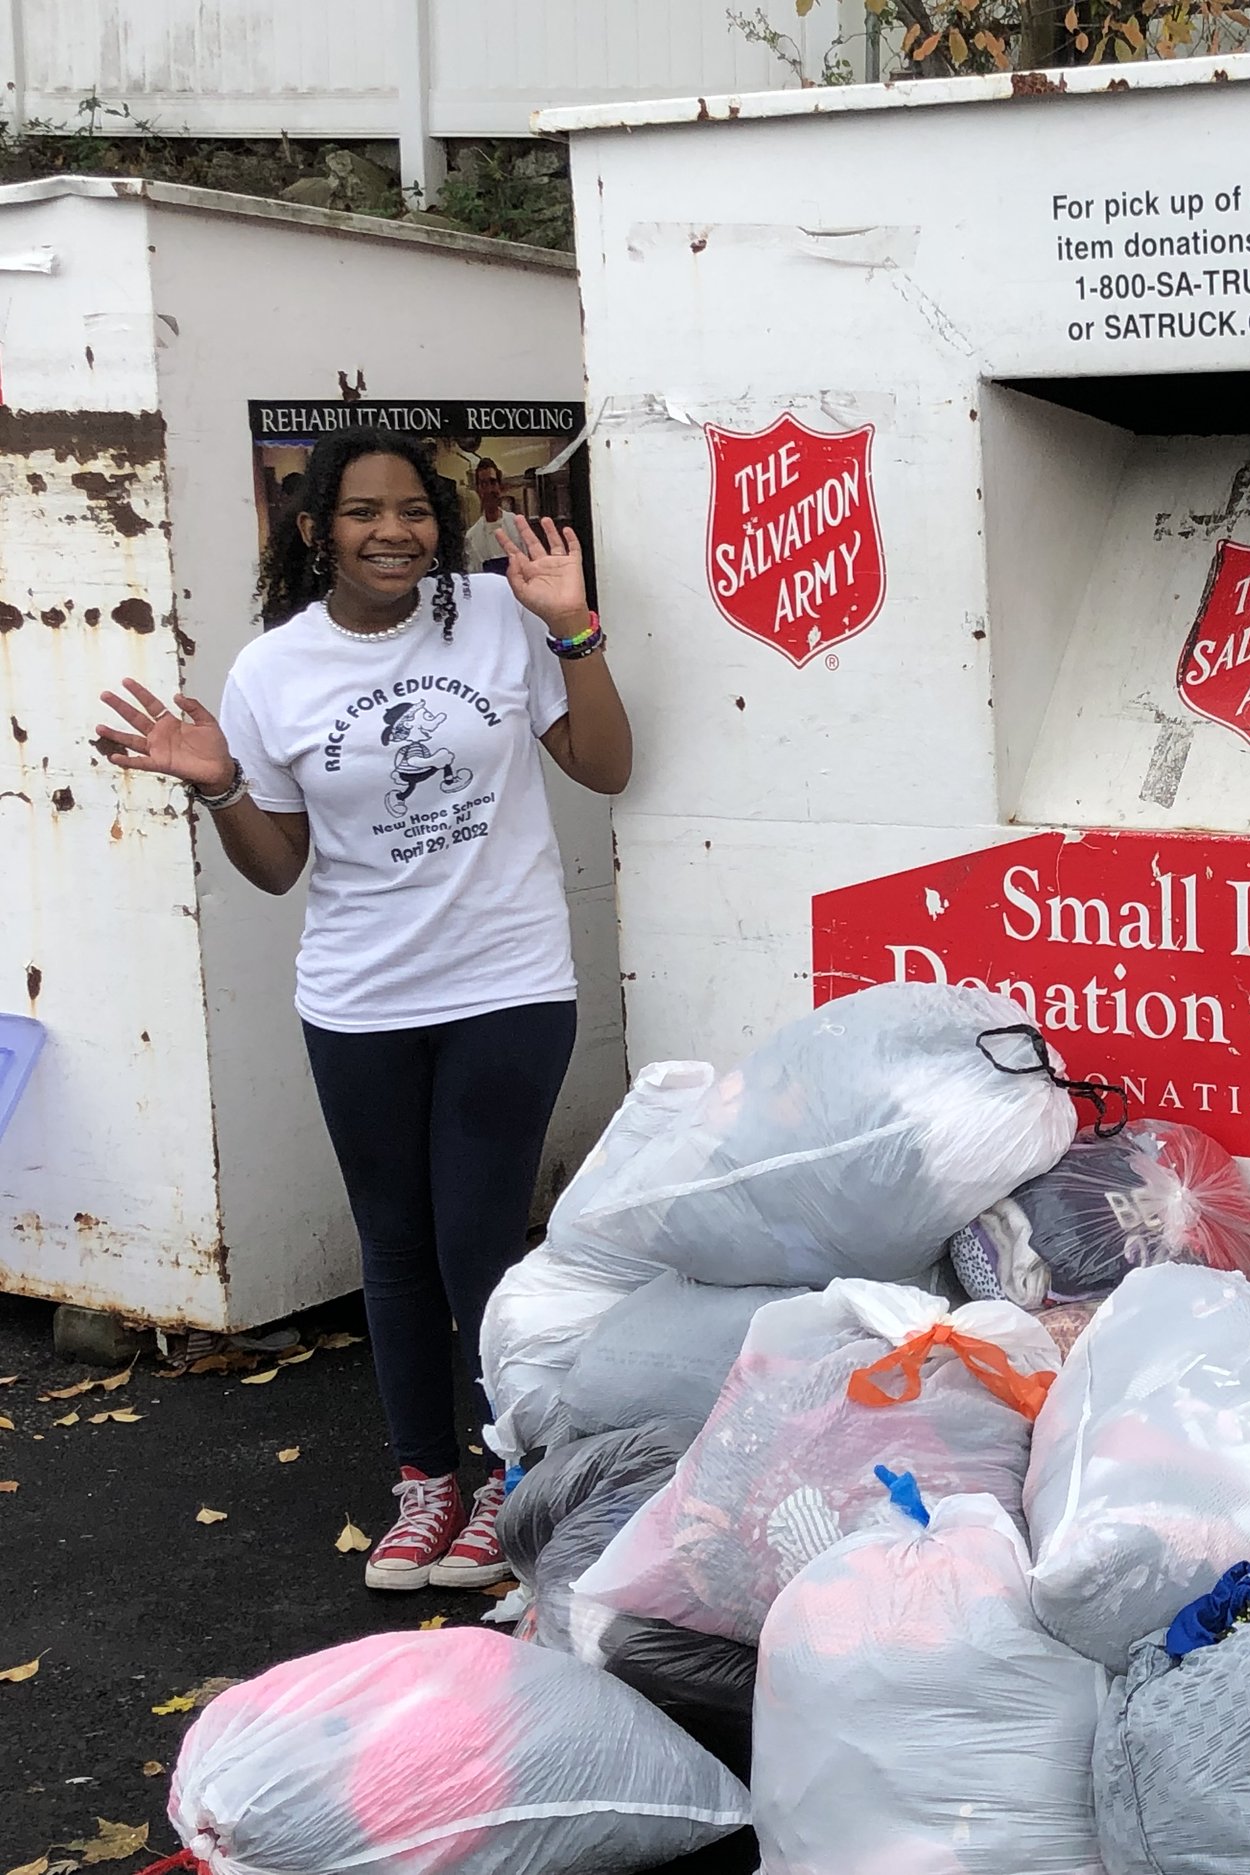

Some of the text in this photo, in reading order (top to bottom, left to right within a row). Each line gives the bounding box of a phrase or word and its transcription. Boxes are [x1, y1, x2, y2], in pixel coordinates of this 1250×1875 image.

[1052, 194, 1094, 220] For
[1104, 190, 1160, 224] pick
[1170, 193, 1204, 220] up
[1214, 185, 1241, 212] of
[1057, 235, 1113, 261] item
[1068, 321, 1094, 341] or
[467, 408, 574, 431] RECYCLING
[734, 441, 800, 514] THE
[715, 458, 860, 597] SALVATION
[774, 530, 861, 632] ARMY
[325, 676, 501, 772] RACE FOR EDUCATION
[373, 792, 495, 836] New Hope School
[404, 811, 471, 839] Clifton, NJ
[391, 822, 489, 863] April 29, 2022
[1002, 865, 1205, 954] Small
[885, 945, 1231, 1044] Dnation
